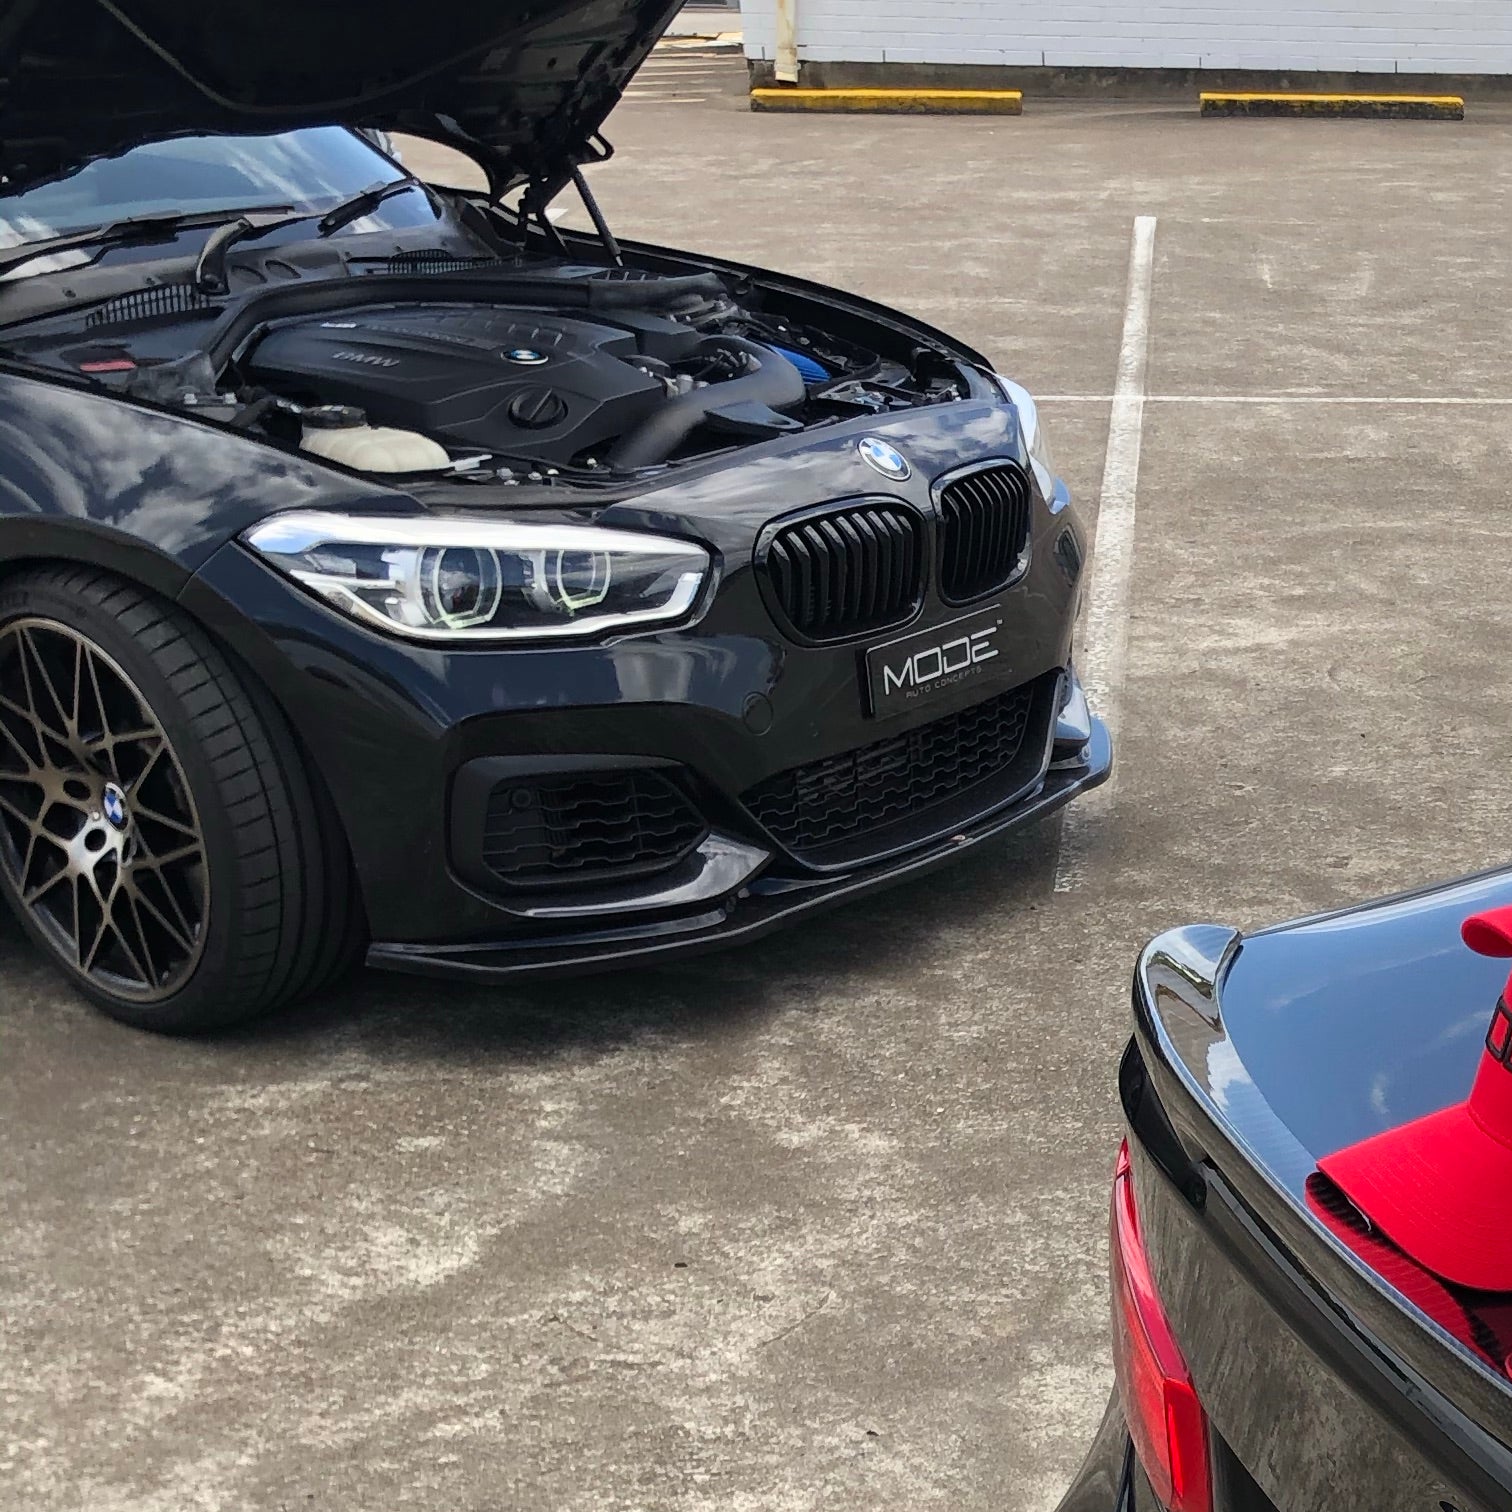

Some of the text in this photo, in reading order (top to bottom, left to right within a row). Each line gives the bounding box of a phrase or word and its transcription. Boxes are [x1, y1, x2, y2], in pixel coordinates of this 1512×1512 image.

[884, 627, 999, 695] MODE
[906, 667, 982, 698] AUTO CONCEPTS
